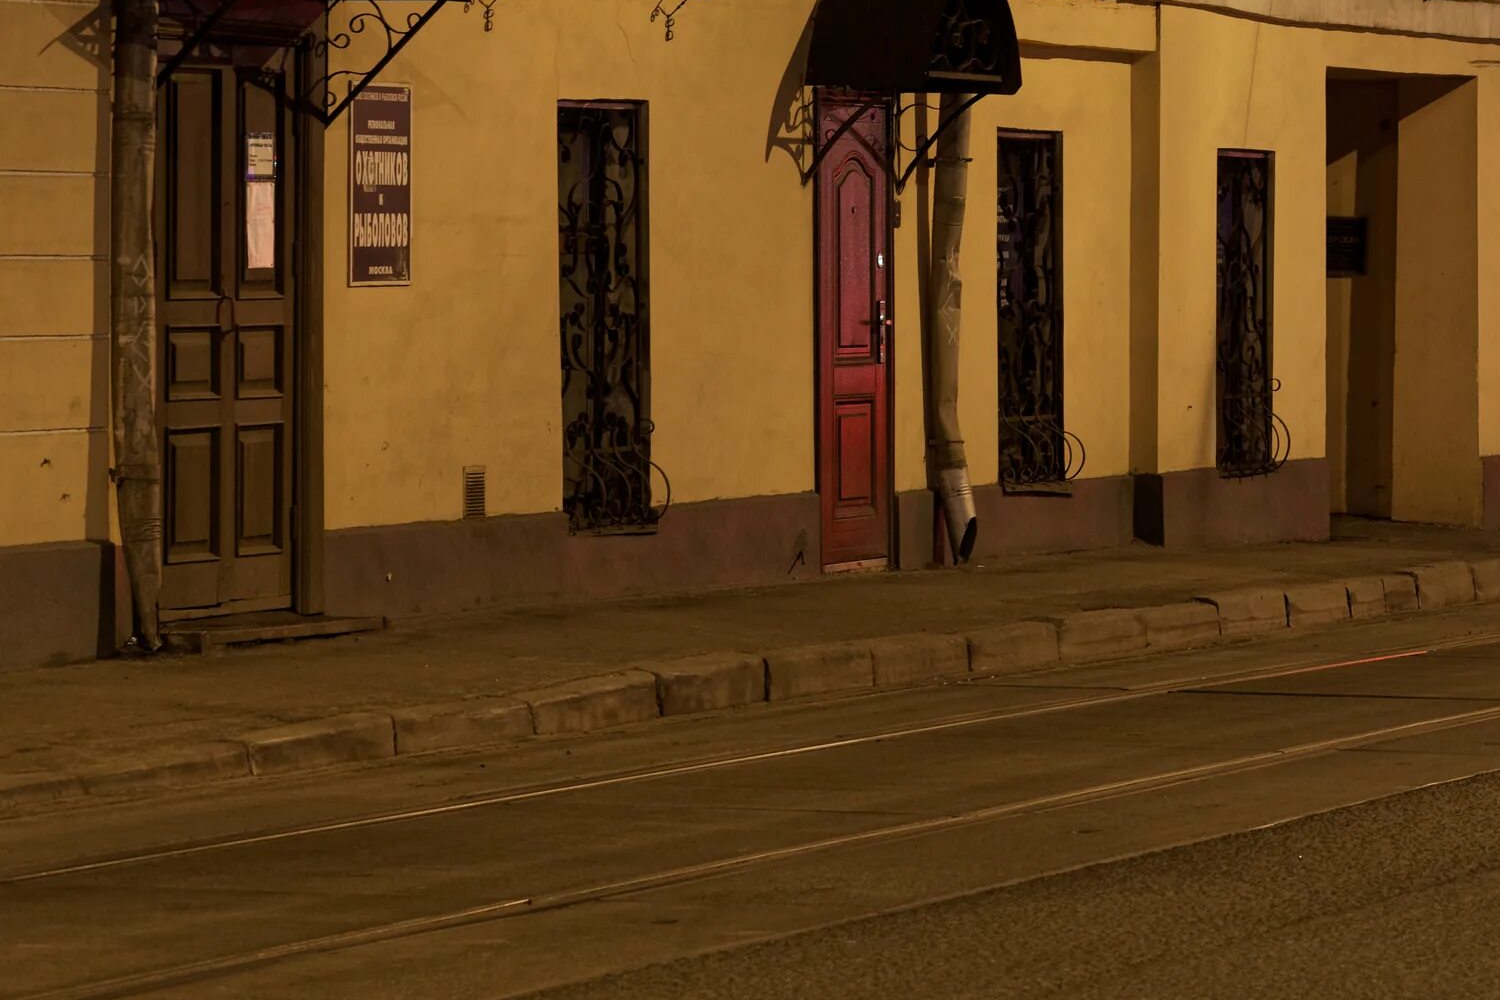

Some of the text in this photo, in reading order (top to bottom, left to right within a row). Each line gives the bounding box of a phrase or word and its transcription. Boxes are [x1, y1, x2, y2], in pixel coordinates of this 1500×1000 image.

[355, 150, 408, 186] ОХОТНИКОВ
[354, 213, 408, 248] РЫБОЛОВОВ
[368, 265, 393, 276] МОСКВА
